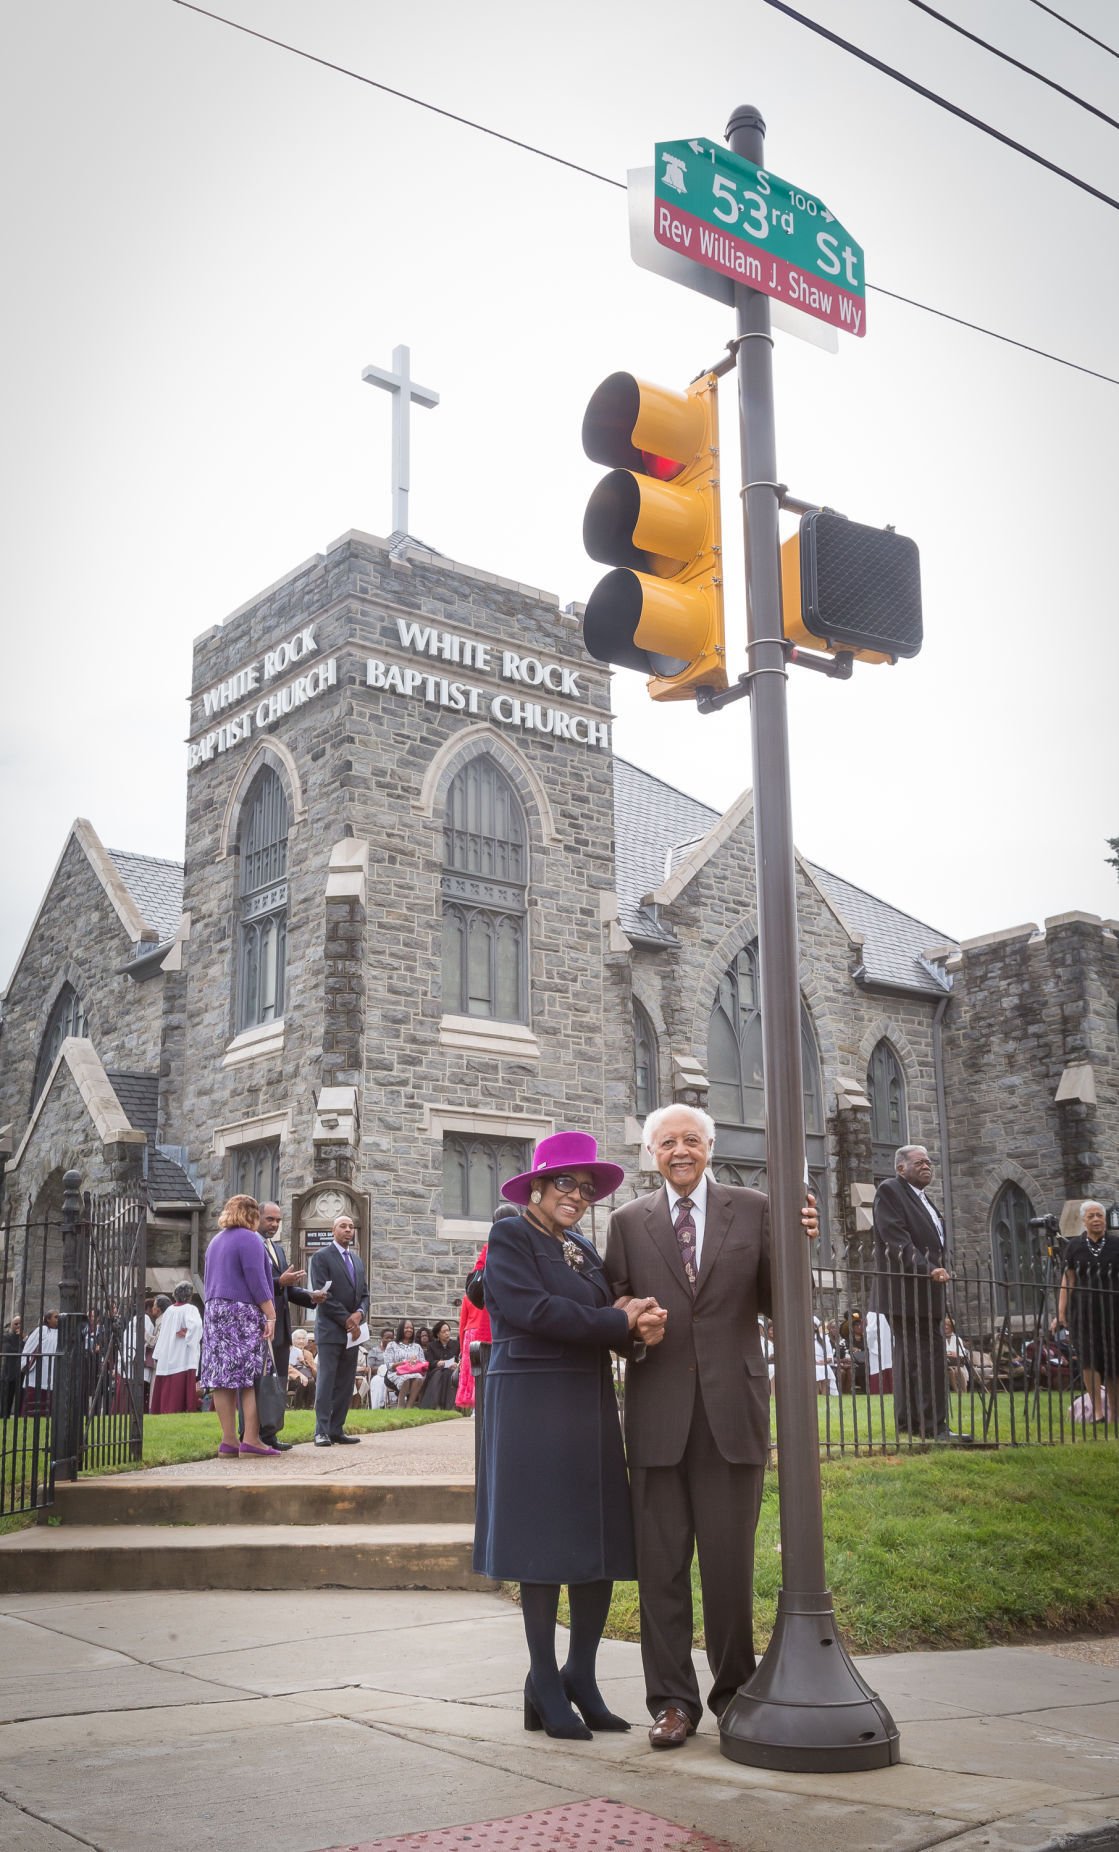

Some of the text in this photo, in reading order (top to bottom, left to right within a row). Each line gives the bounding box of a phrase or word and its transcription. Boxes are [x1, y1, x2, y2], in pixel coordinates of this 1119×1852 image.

[709, 148, 818, 217] 1 S 100
[659, 207, 862, 334] Rev William J. Shaw Wy
[712, 173, 858, 287] 53rd St
[203, 623, 318, 717] WHITE ROCK
[366, 658, 608, 749] BAPTIST CHURCH
[396, 618, 580, 697] WHITE ROCK
[187, 658, 337, 770] BAPTIST CHURCH
